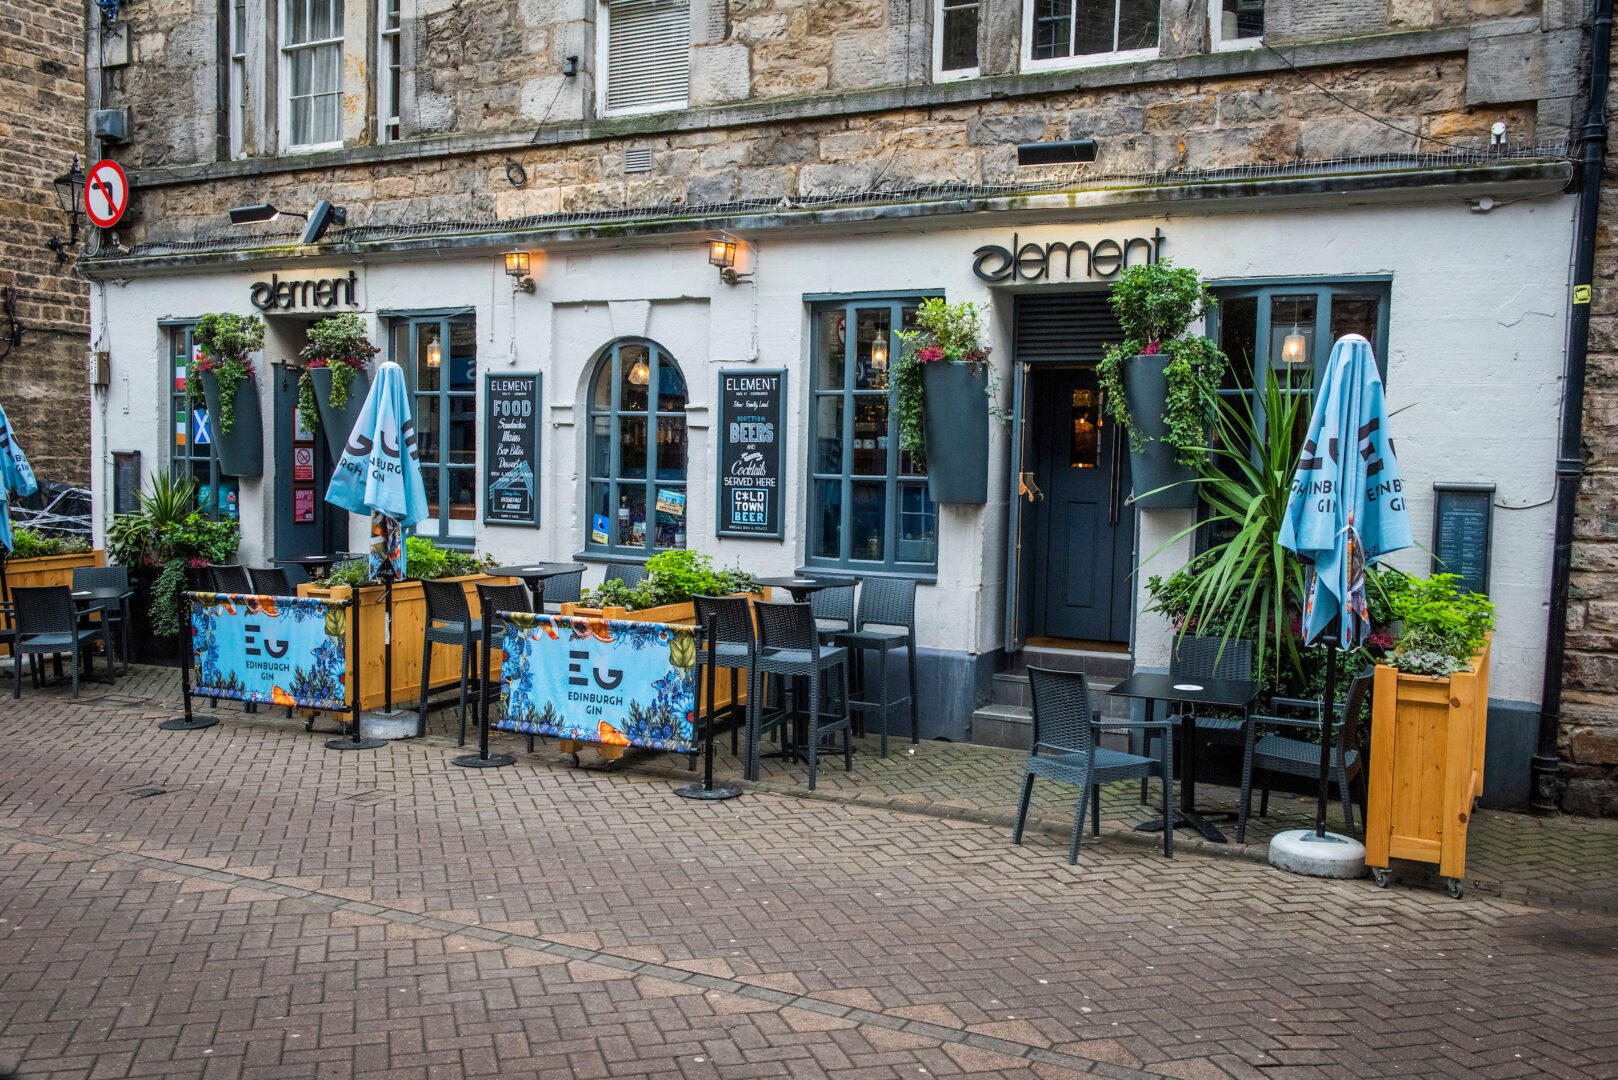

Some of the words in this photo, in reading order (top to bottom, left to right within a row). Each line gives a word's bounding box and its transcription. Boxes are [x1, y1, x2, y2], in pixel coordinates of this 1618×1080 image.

[973, 227, 1166, 282] element
[250, 270, 358, 310] element
[491, 380, 534, 391] ELEMENT
[726, 378, 778, 391] ELEMENT
[493, 399, 531, 417] FOOD
[729, 422, 774, 443] BEERS
[731, 459, 766, 476] Cocktails
[724, 477, 753, 487] SERVED
[756, 477, 776, 487] HERE
[735, 501, 764, 512] TOWN
[734, 511, 764, 522] BEER
[245, 624, 289, 659] EG
[246, 661, 290, 672] EDINBURGH
[569, 650, 624, 691] EG
[261, 672, 274, 680] GIN
[568, 691, 623, 706] EDINBURGH
[586, 705, 603, 715] GIN
